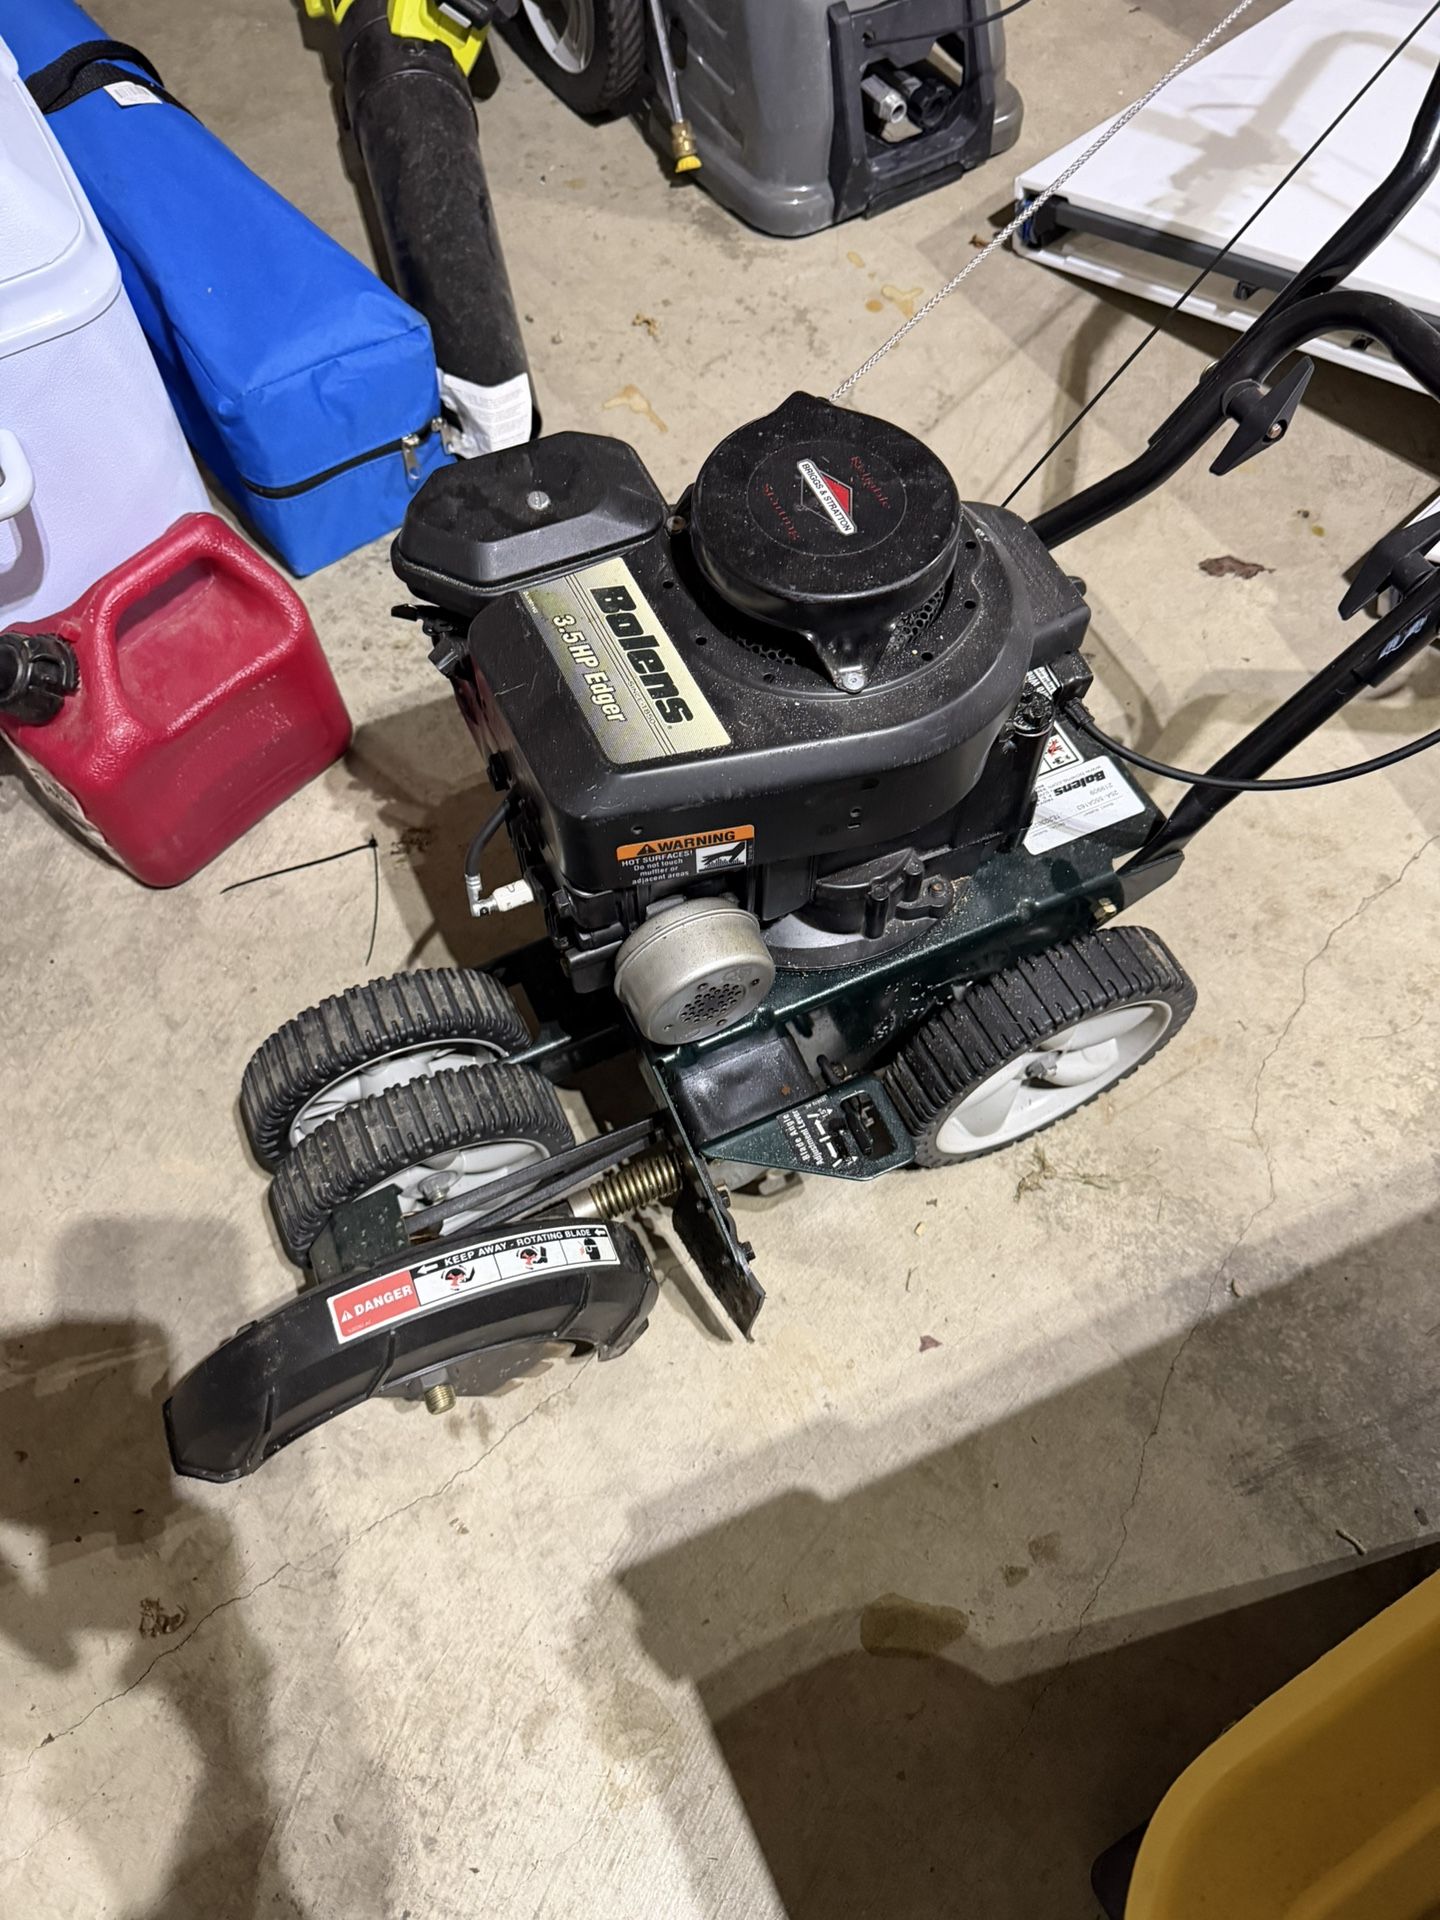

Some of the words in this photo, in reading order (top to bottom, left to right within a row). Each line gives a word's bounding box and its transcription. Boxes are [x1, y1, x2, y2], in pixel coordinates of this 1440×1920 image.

[801, 462, 824, 490] BRIGGS
[819, 488, 827, 496] &
[823, 495, 852, 532] STRATTON
[552, 613, 584, 644] 3.5
[569, 642, 600, 668] HP
[590, 585, 695, 725] Bolens
[583, 670, 628, 724] Edger
[1053, 770, 1106, 797] Bolens
[658, 831, 736, 852] WARNING
[621, 858, 640, 867] HOT
[642, 850, 693, 864] SURFACES!
[661, 858, 683, 868] touch
[632, 873, 666, 886] adjacent
[667, 870, 689, 880] areas
[640, 867, 669, 877] muffler
[783, 1114, 799, 1136] Angle
[791, 1109, 805, 1130] Lever
[794, 1138, 811, 1161] Blade
[800, 1130, 824, 1166] Adjustment
[444, 1250, 475, 1267] KEEP
[478, 1242, 507, 1257] AWAY
[517, 1231, 563, 1247] ROTATING
[564, 1228, 592, 1239] BLADE
[354, 1285, 414, 1317] DANGER
